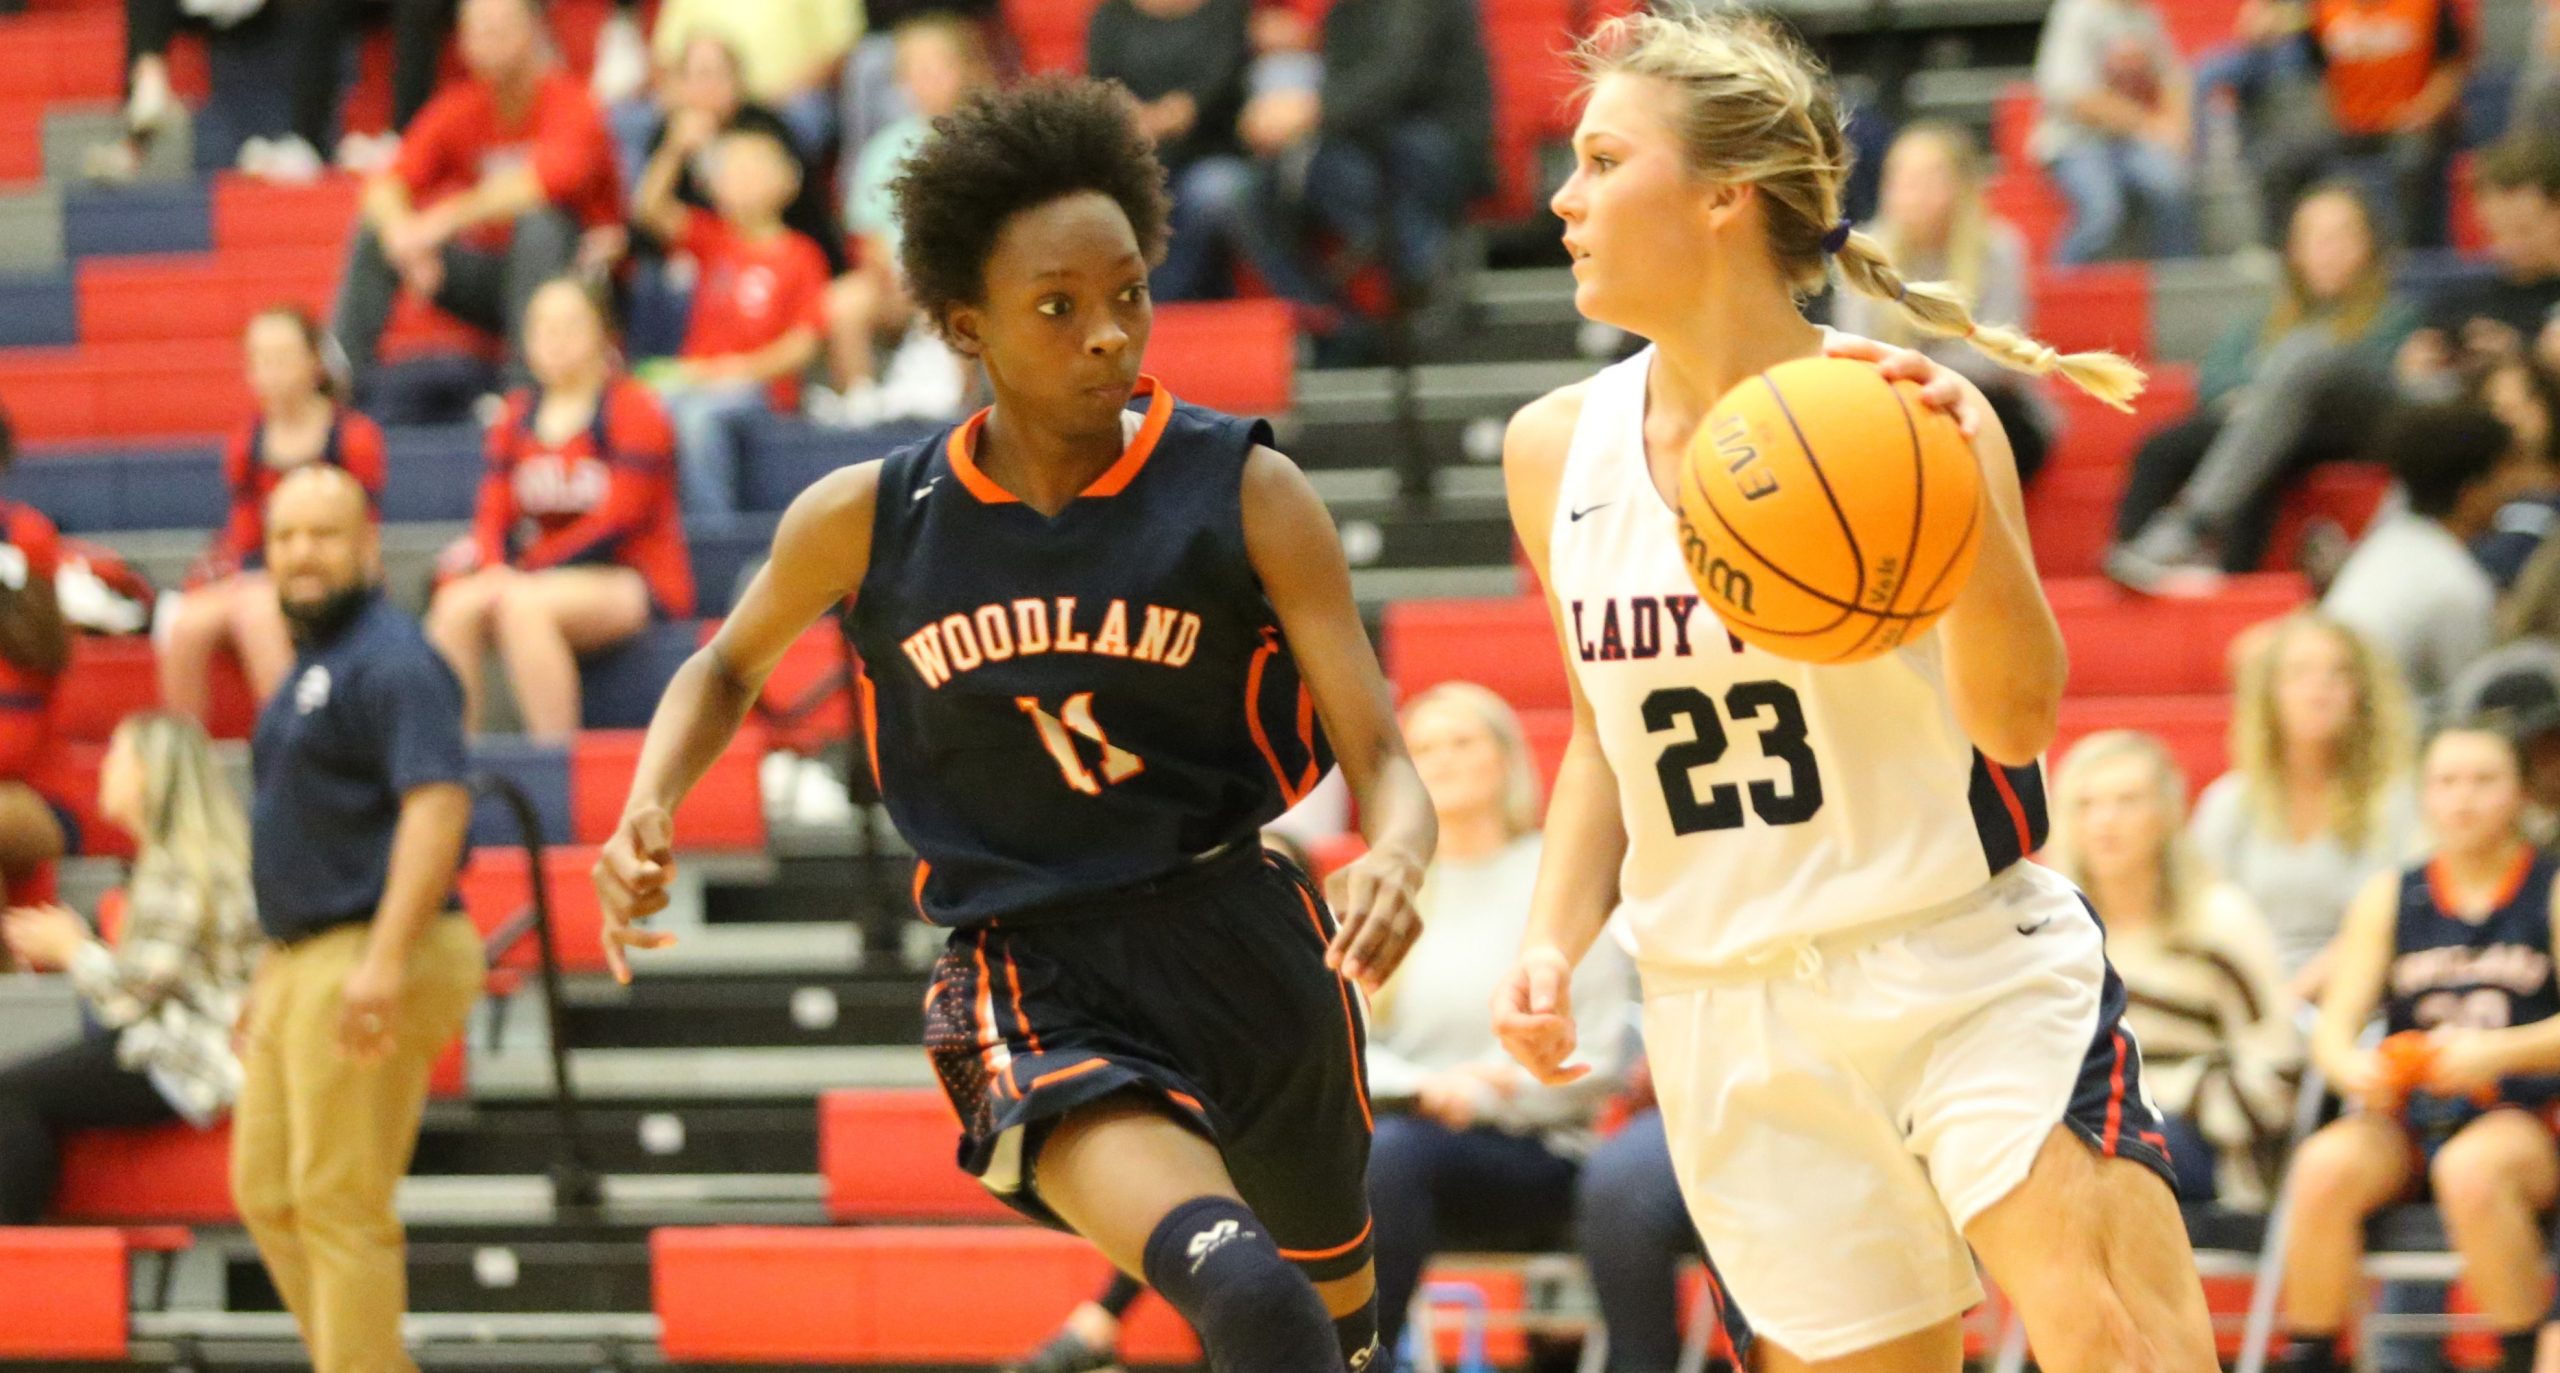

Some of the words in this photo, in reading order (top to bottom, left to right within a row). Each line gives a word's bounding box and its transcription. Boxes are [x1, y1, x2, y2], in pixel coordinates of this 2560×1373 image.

[901, 596, 1202, 690] WOODLAND
[1572, 594, 1699, 662] LADY
[1014, 692, 1146, 796] 11
[1641, 678, 1824, 837] 23
